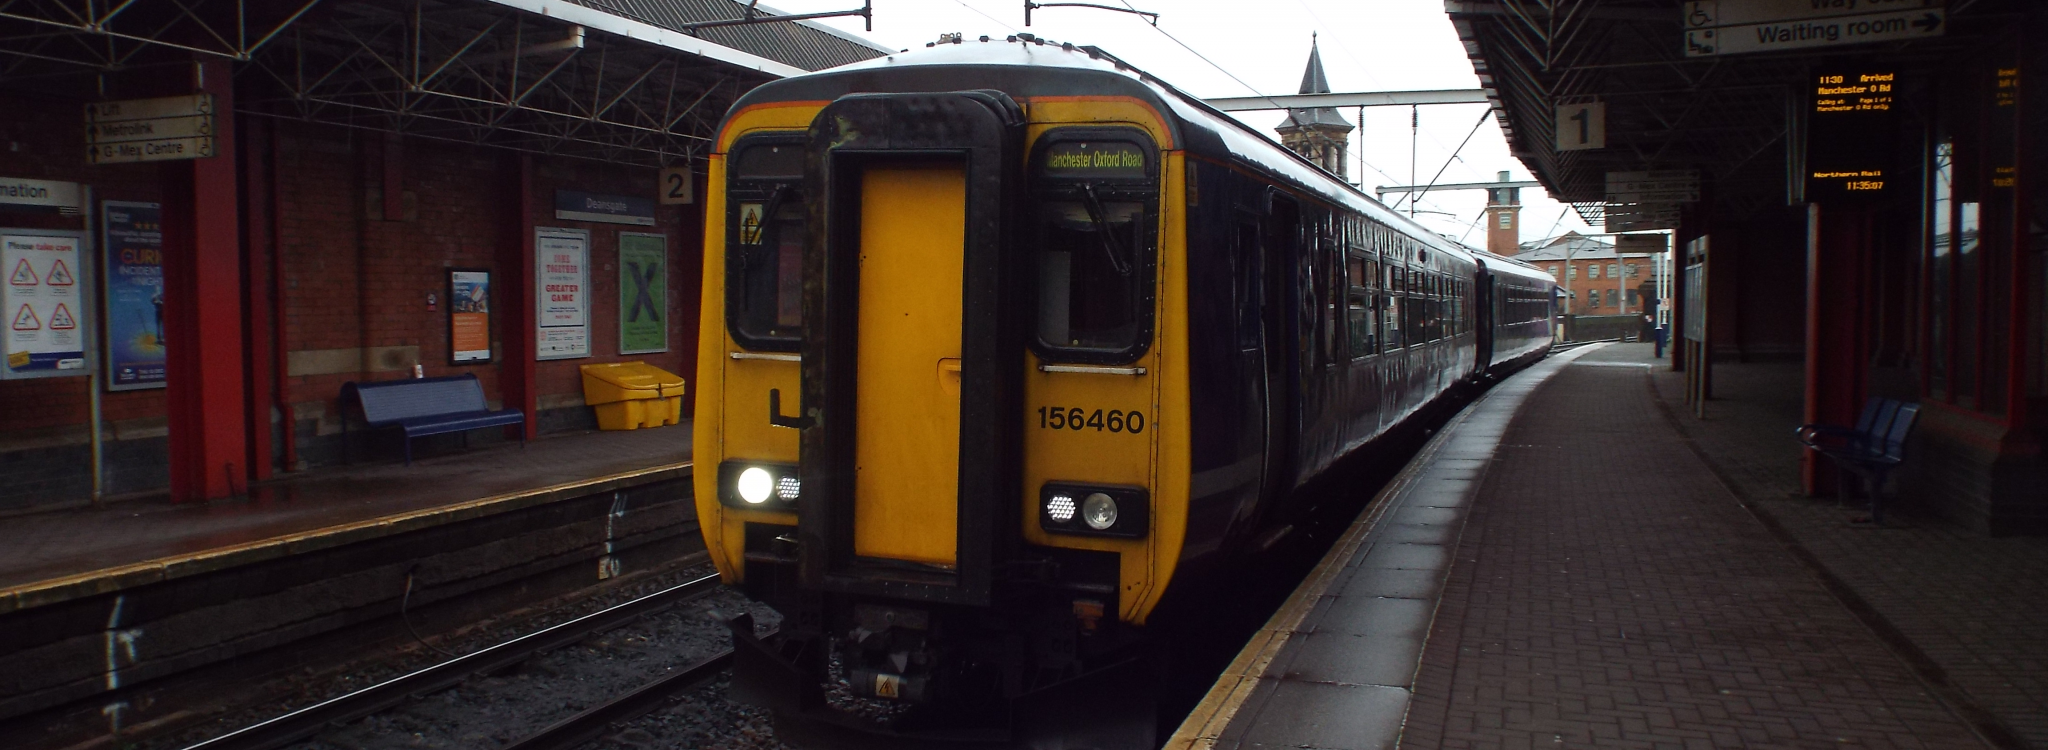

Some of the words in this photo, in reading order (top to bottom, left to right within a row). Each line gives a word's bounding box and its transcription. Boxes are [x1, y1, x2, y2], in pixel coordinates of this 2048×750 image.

[1756, 22, 1839, 43] Waiting
[1848, 17, 1906, 36] room
[1820, 75, 1843, 84] 11:30
[1860, 73, 1894, 82] Arrived
[1818, 86, 1867, 95] Manchester
[1879, 84, 1891, 93] Rd
[102, 122, 154, 136] Metrolink
[1570, 108, 1588, 145] 1
[145, 142, 184, 156] Centre
[1093, 150, 1120, 168] Oxford
[1122, 150, 1143, 168] Road
[668, 173, 684, 199] 2
[586, 197, 627, 213] Deansgate
[545, 284, 579, 293] GREATER
[627, 262, 660, 323] X
[551, 294, 574, 302] GAME
[1038, 406, 1145, 434] 156460
